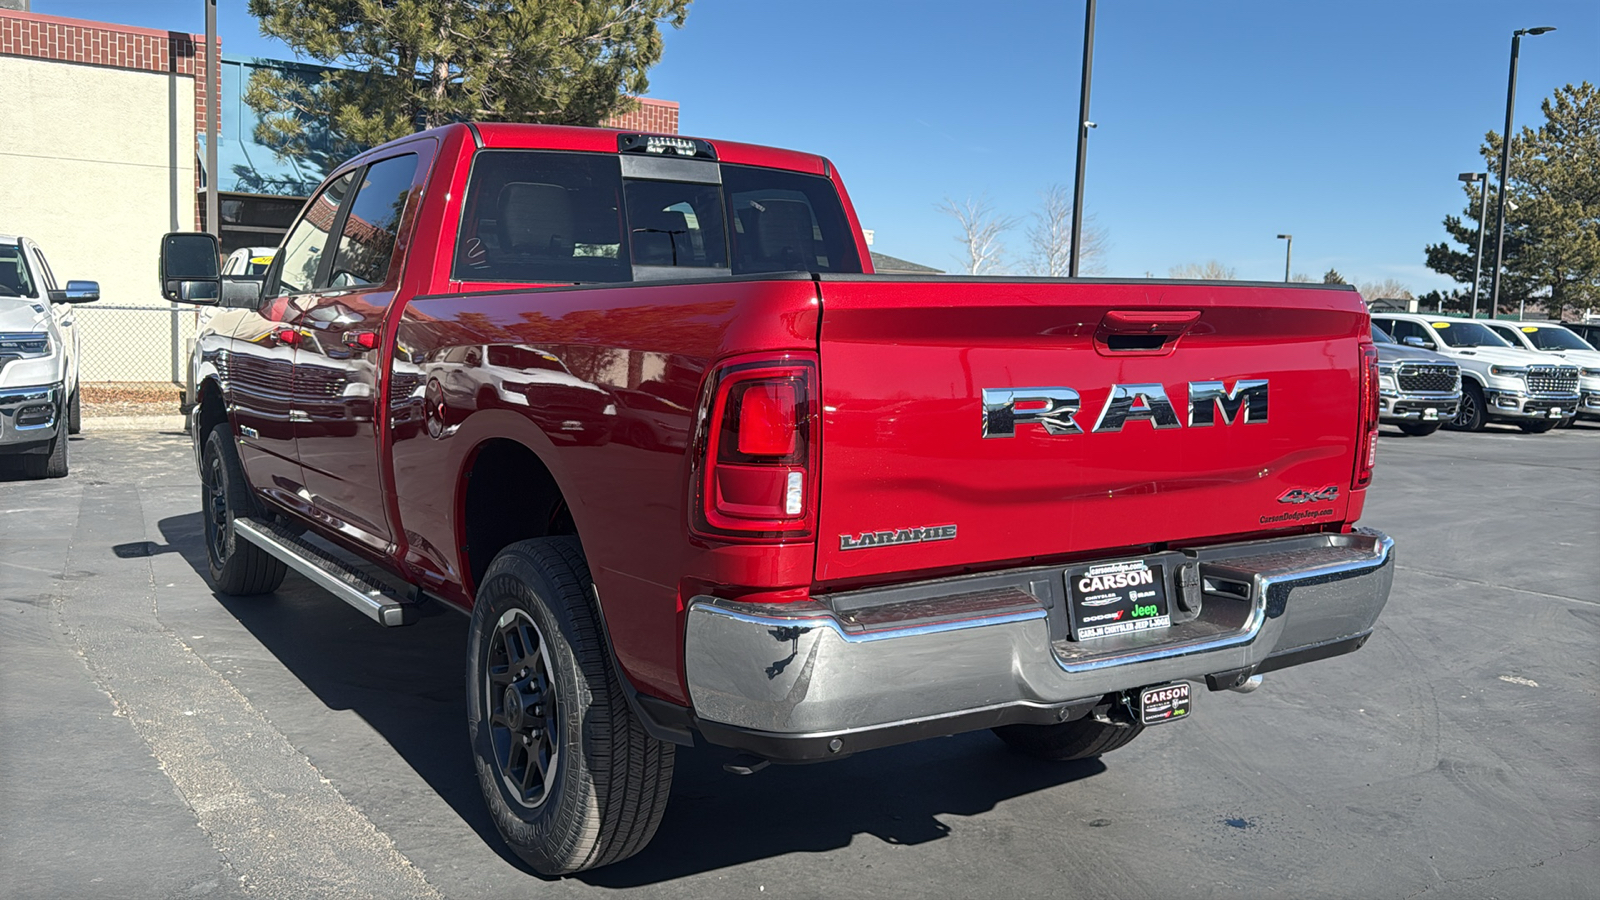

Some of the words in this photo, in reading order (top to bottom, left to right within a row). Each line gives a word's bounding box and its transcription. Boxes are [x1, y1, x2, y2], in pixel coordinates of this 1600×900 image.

[981, 379, 1269, 439] RAM
[1277, 486, 1339, 504] 4x4
[1259, 508, 1333, 523] CarsonDodgeJeep.com
[840, 524, 957, 551] LARAMIE
[1079, 570, 1153, 592] CARSON
[1131, 604, 1158, 617] Jeep
[1144, 687, 1188, 704] CARSON
